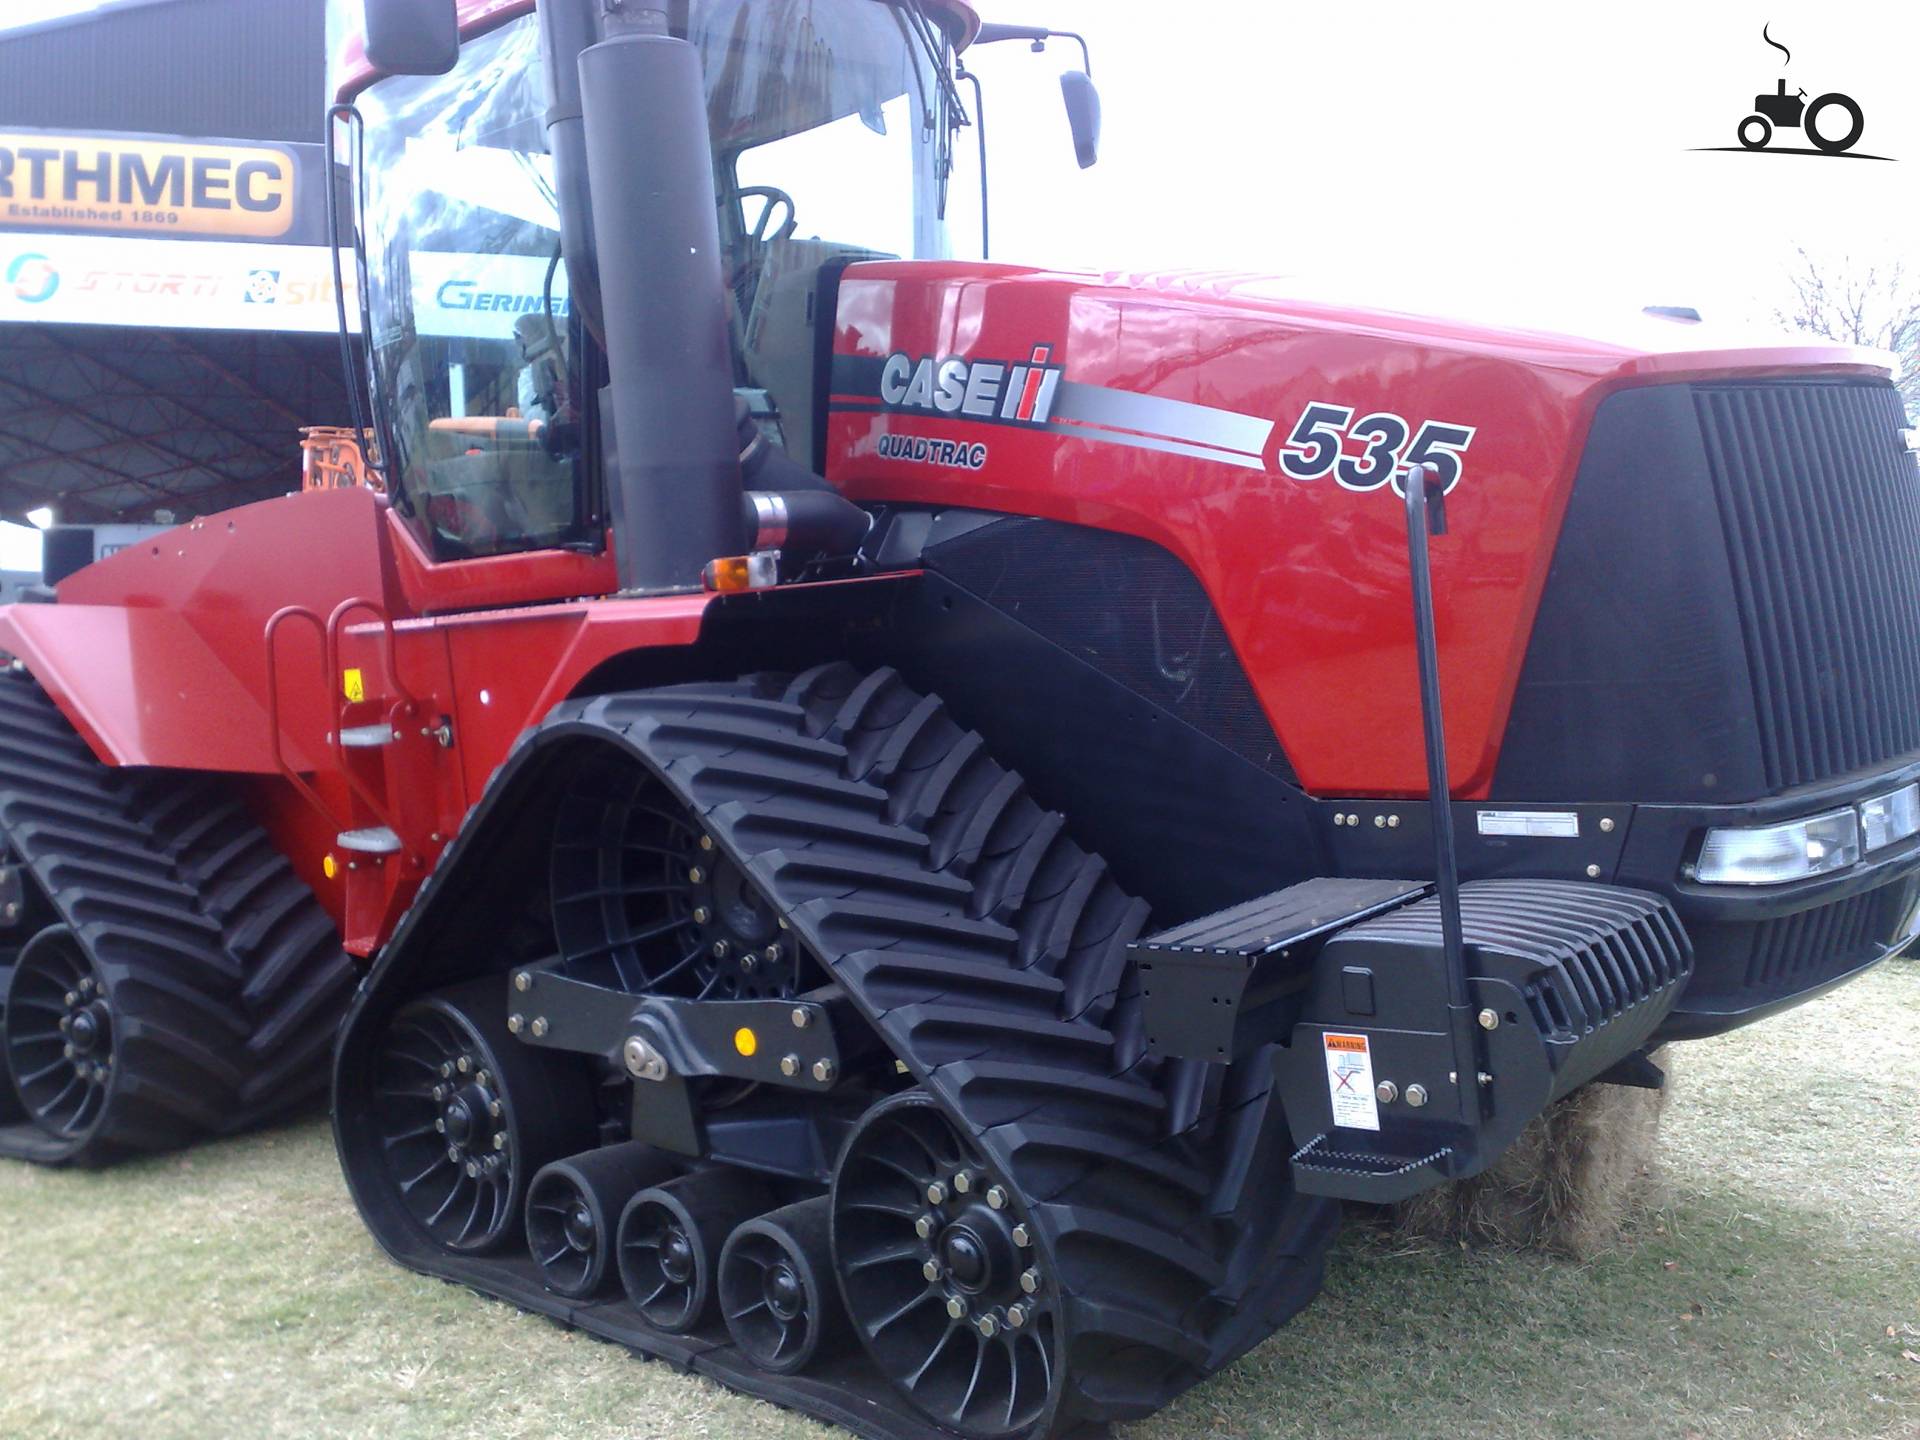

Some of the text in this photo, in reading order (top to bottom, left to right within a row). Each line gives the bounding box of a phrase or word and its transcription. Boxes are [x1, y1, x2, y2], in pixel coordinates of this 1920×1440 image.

[8, 203, 179, 225] Established 1869
[437, 279, 569, 315] GERING
[880, 353, 1004, 417] CASE
[878, 433, 988, 471] QUADTRAC
[1278, 400, 1478, 500] 535
